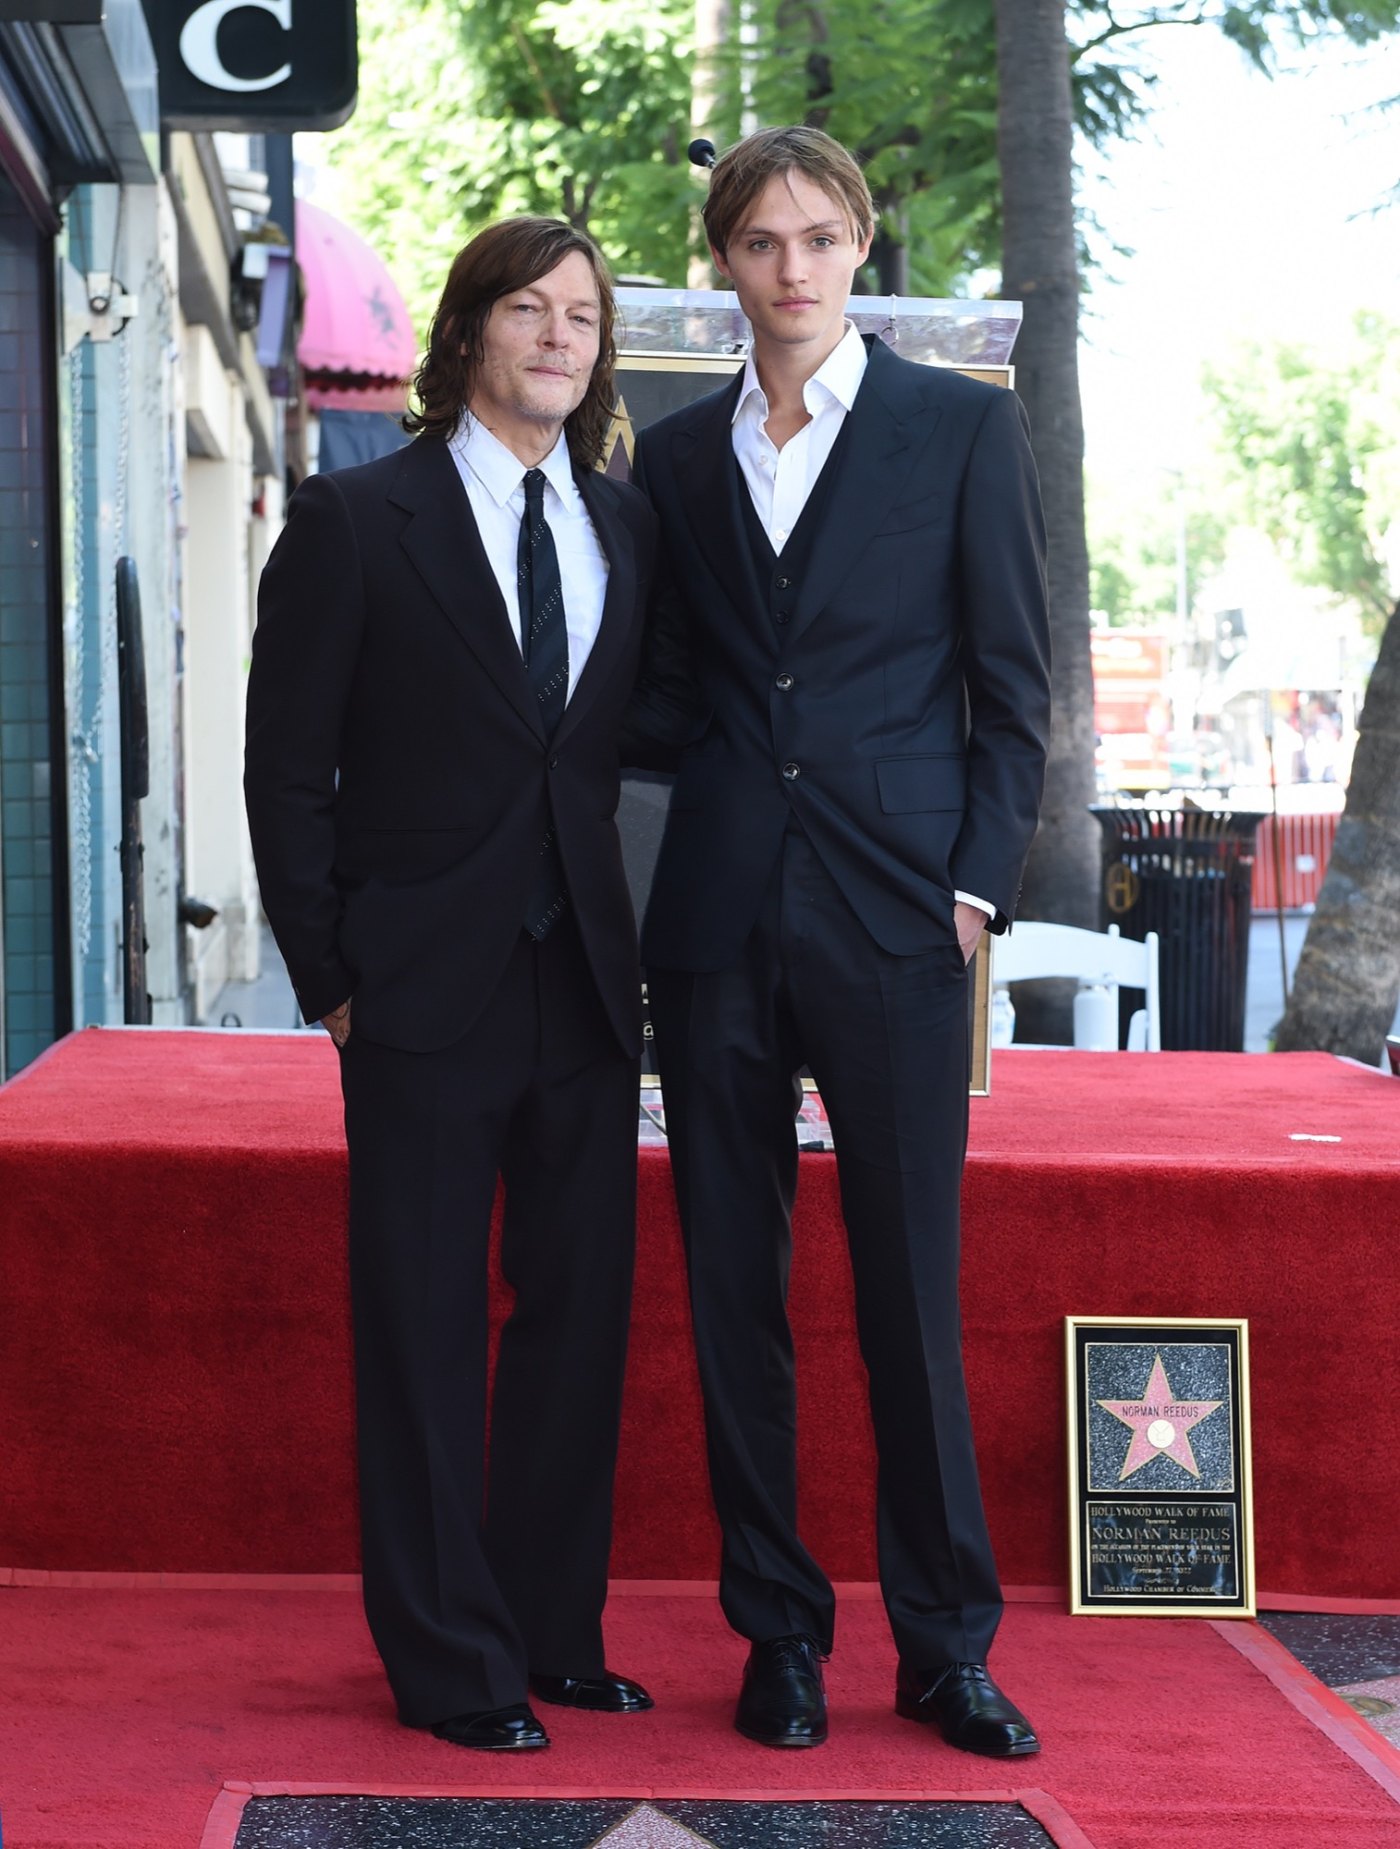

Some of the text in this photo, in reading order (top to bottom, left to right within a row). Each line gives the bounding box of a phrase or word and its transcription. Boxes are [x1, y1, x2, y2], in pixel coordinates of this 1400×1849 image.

[179, 0, 292, 92] C
[1122, 1406, 1199, 1417] NORMAN REEDUS
[1091, 1507, 1230, 1517] HOLLYWOOD WALK OF FAME
[1093, 1527, 1231, 1540] NORMAN REEDUS
[1092, 1553, 1231, 1564] HOLLYWOOD WALK OF FAME
